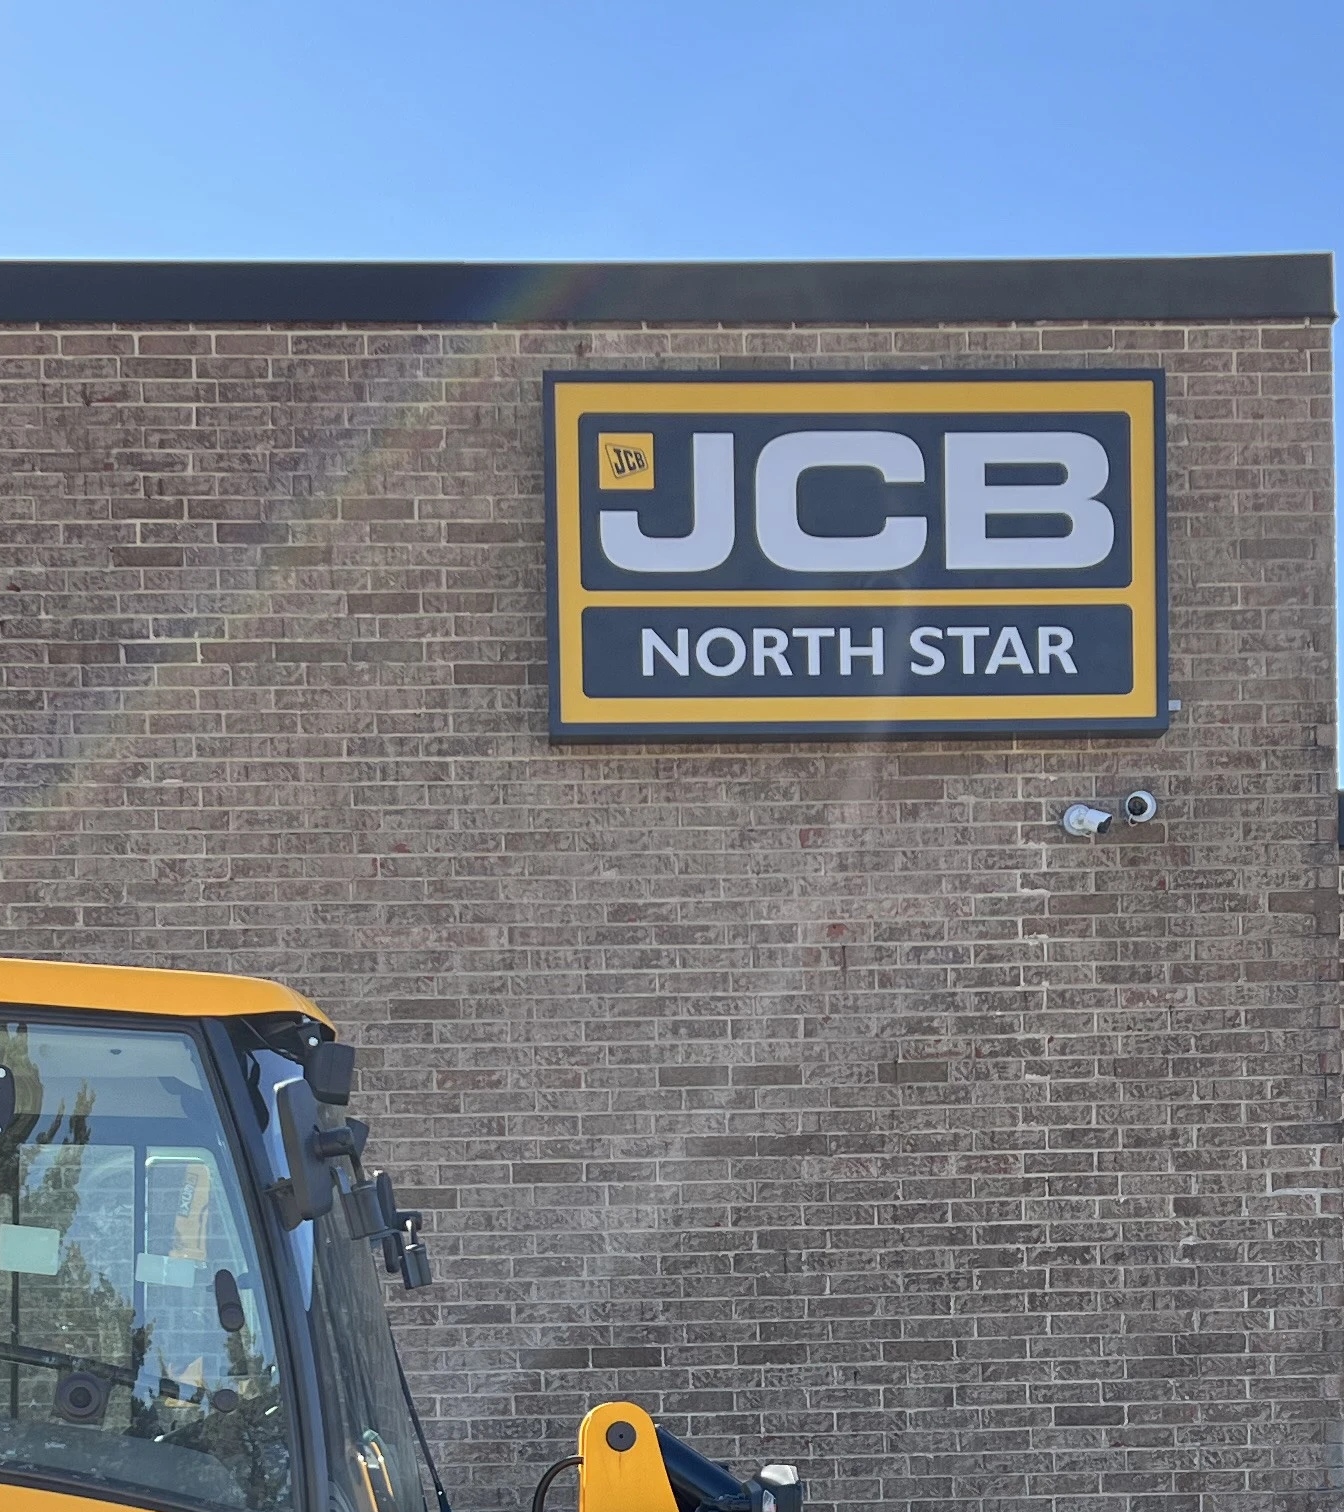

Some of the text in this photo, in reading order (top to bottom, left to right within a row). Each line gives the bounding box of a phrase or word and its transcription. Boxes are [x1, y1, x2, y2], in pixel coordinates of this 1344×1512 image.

[613, 447, 645, 475] JCB
[599, 431, 1115, 572] JCB
[641, 626, 1078, 677] NORTH STAR
